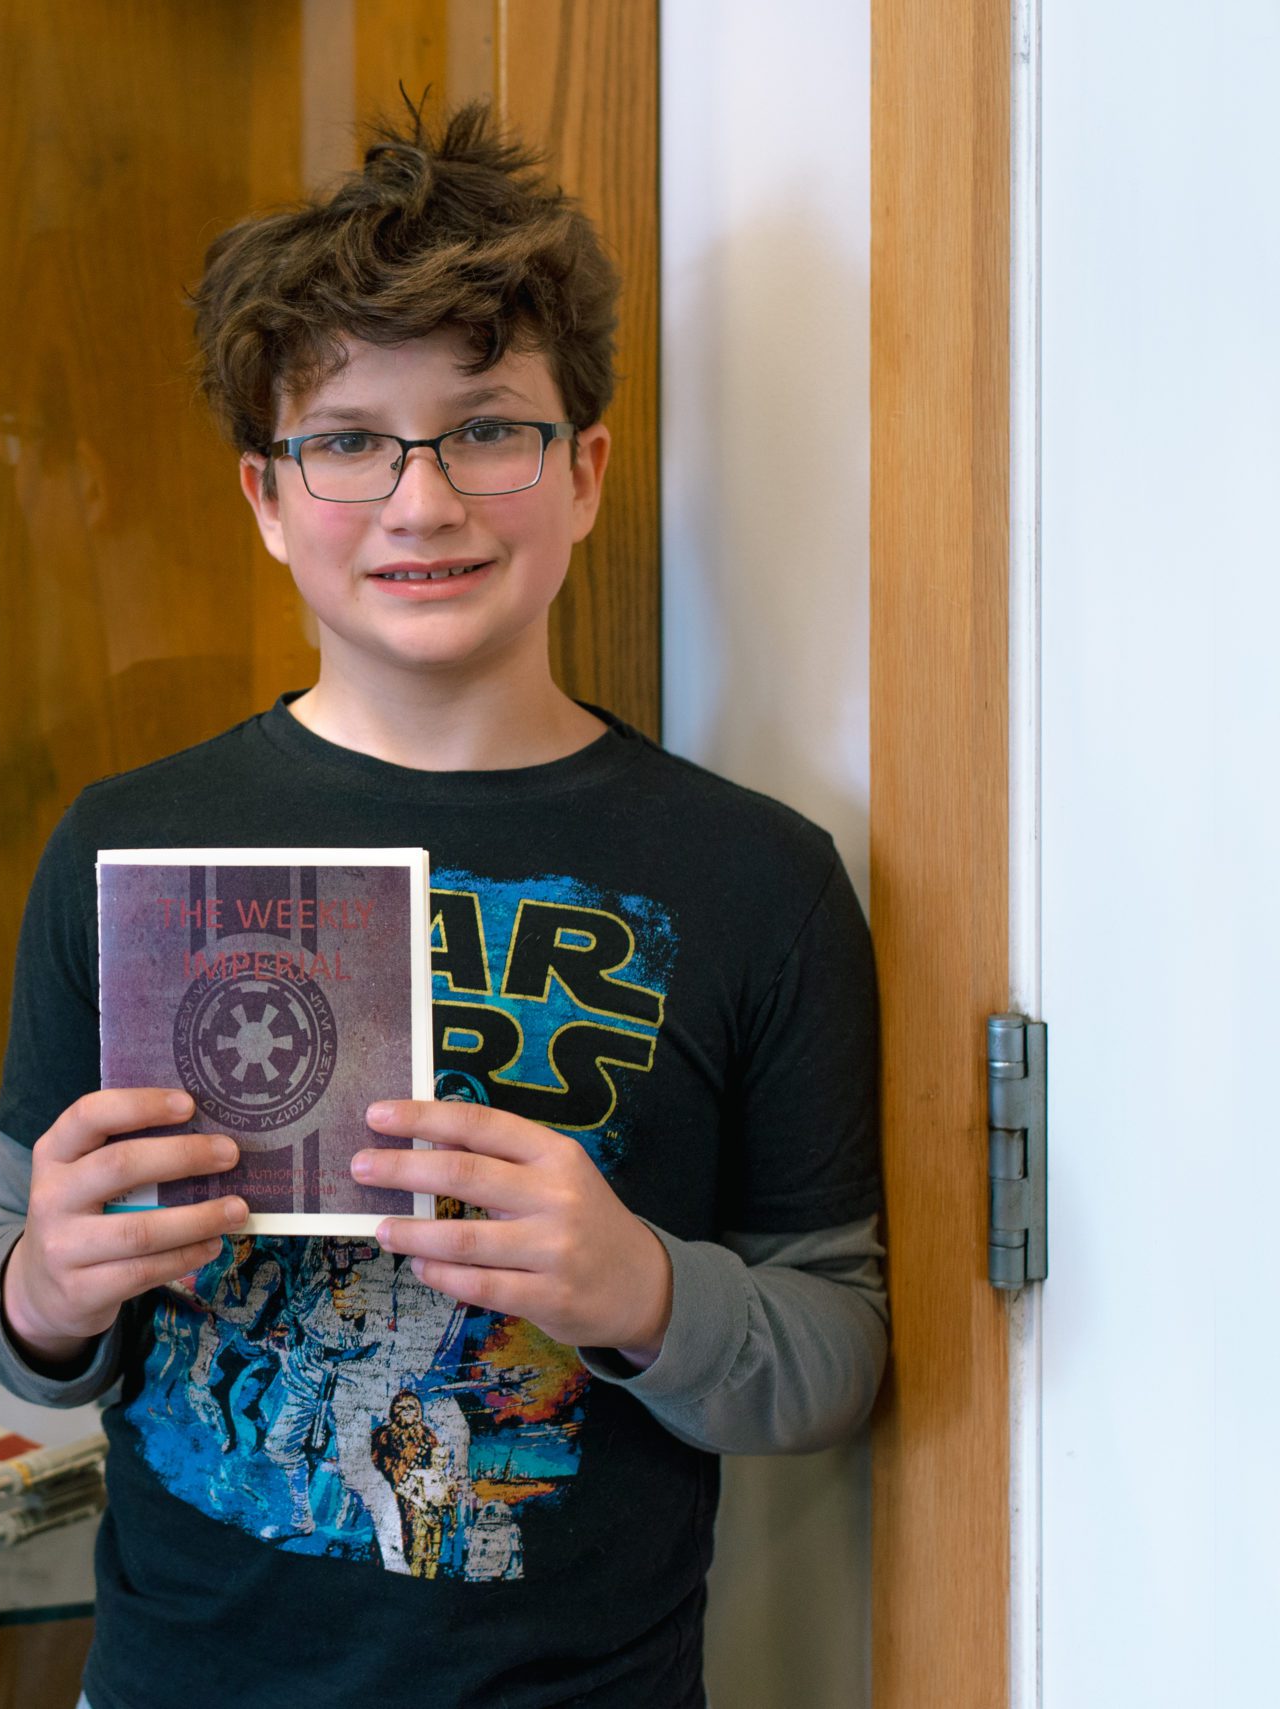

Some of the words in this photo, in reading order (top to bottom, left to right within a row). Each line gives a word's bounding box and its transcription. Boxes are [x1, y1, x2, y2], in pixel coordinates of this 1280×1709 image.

[157, 898, 223, 929] THE
[236, 898, 376, 929] WEEKLY
[183, 950, 352, 981] IMPERIAL
[428, 887, 666, 1029] AR
[431, 998, 657, 1132] RS
[248, 1169, 308, 1180] AUTHORITY
